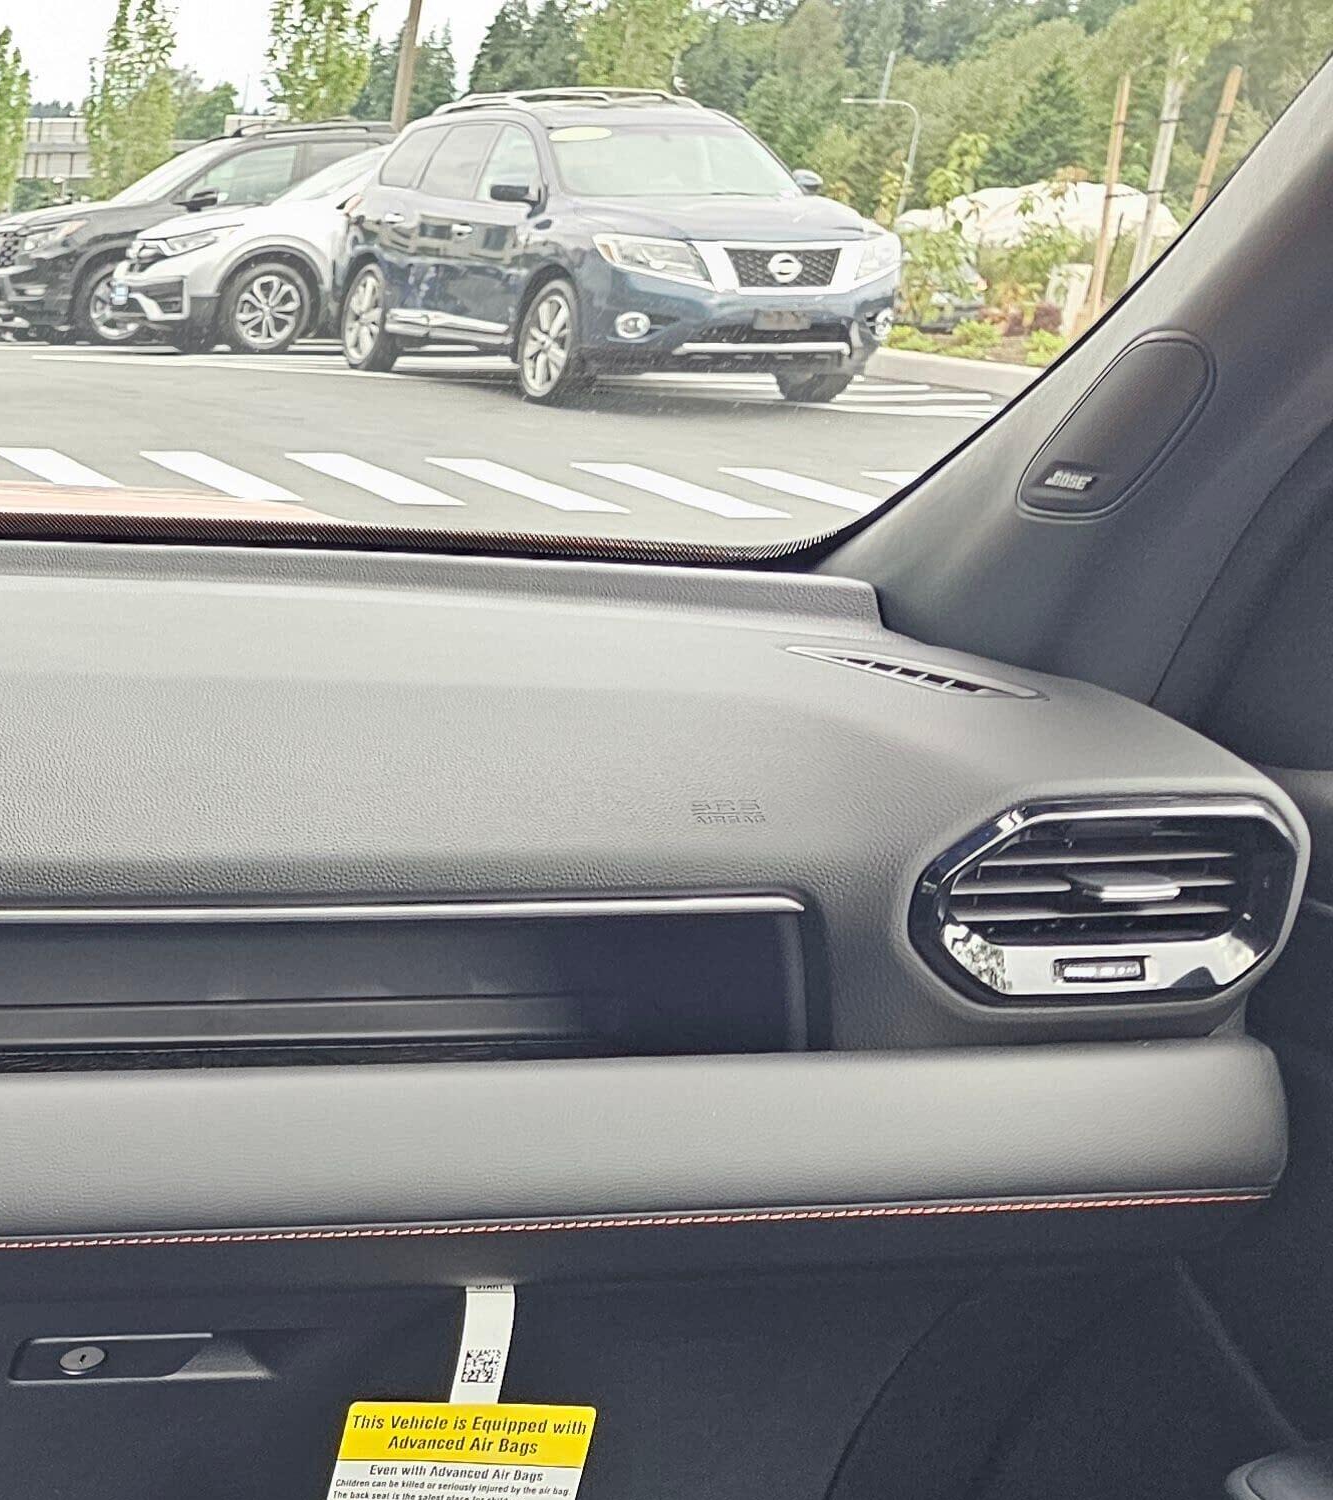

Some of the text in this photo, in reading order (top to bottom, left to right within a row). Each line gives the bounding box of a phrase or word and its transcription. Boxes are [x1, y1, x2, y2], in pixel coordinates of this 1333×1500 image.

[353, 1415, 586, 1435] This Vehicle is Equipped with
[387, 1436, 538, 1456] Advanced Air Bags
[369, 1464, 544, 1483] Even with Advanced Air Bags
[333, 1491, 347, 1499] The
[350, 1491, 369, 1499] back
[371, 1492, 389, 1500] seat
[392, 1492, 400, 1500] is
[335, 1479, 369, 1487] Children
[389, 1480, 399, 1488] be
[401, 1480, 425, 1489] killed
[438, 1482, 477, 1493] seriously
[478, 1484, 508, 1493] injured
[510, 1485, 520, 1495] by
[523, 1485, 536, 1494] the
[538, 1486, 551, 1494] air
